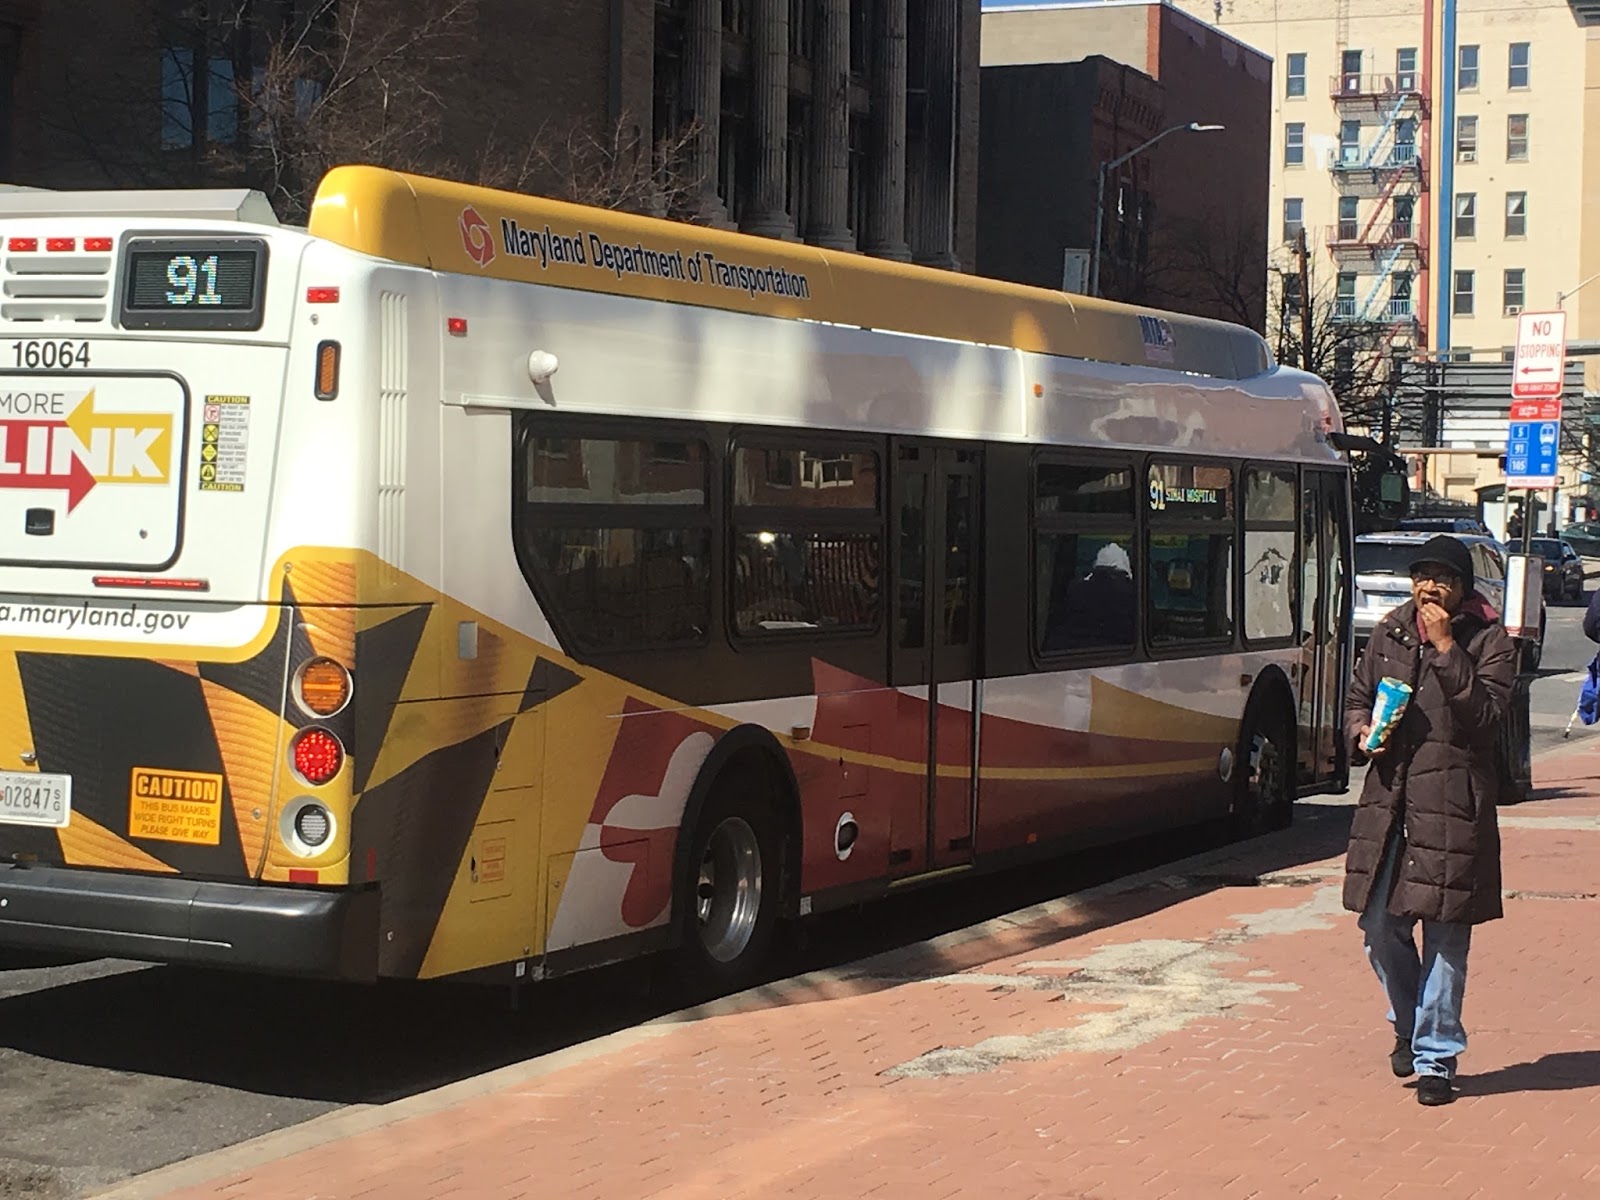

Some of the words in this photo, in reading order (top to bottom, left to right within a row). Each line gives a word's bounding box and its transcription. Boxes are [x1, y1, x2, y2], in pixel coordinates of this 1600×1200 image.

[501, 218, 586, 269] Maryland
[588, 232, 685, 279] Department
[687, 251, 703, 283] of
[703, 252, 810, 299] Transportation
[165, 255, 222, 304] 91
[1532, 320, 1551, 336] NO
[12, 341, 91, 368] 16064
[1519, 344, 1561, 359] STOPPING
[207, 396, 248, 404] CAUTION
[1514, 444, 1525, 455] 91
[1150, 480, 1166, 510] 91
[1186, 489, 1218, 503] HOSPITAL
[0, 602, 190, 634] a.maryland.gov
[4, 785, 51, 810] 02847
[138, 775, 217, 801] CAUTION
[140, 800, 159, 811] THIS
[161, 802, 179, 813] BUS
[181, 804, 211, 816] MAKES
[134, 812, 156, 823] WIDE
[158, 814, 184, 825] RIGHT
[186, 816, 216, 828] TURNS
[140, 823, 169, 836] PLEASE
[172, 827, 190, 838] GIVE
[192, 830, 210, 839] WAY
